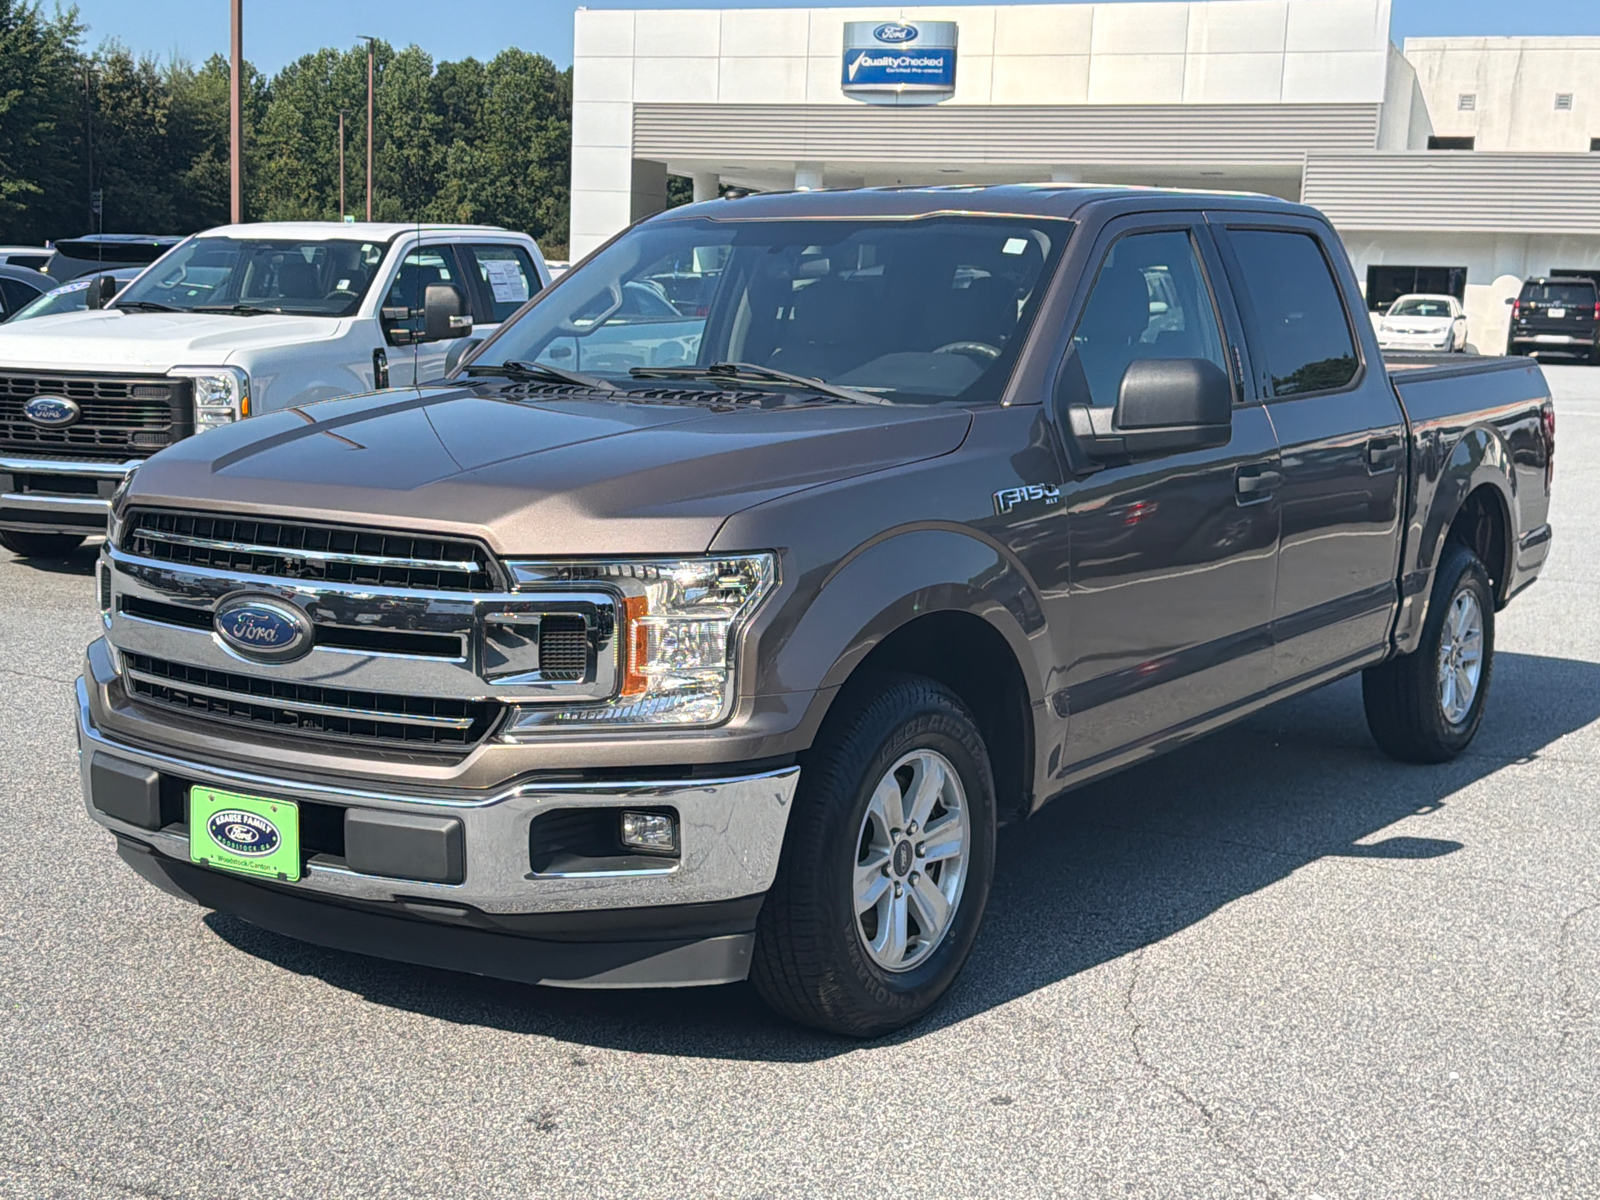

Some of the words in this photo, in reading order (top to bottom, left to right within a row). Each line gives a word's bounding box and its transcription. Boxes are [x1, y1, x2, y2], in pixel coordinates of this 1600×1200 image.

[881, 26, 908, 39] Ford
[861, 57, 943, 68] QualityChecked
[35, 404, 61, 418] Ford
[1045, 497, 1059, 505] XLT
[233, 612, 280, 643] Ford
[215, 813, 242, 826] KRAUSE
[243, 815, 273, 834] FAMILY
[230, 825, 254, 841] Ford
[259, 842, 270, 851] GA
